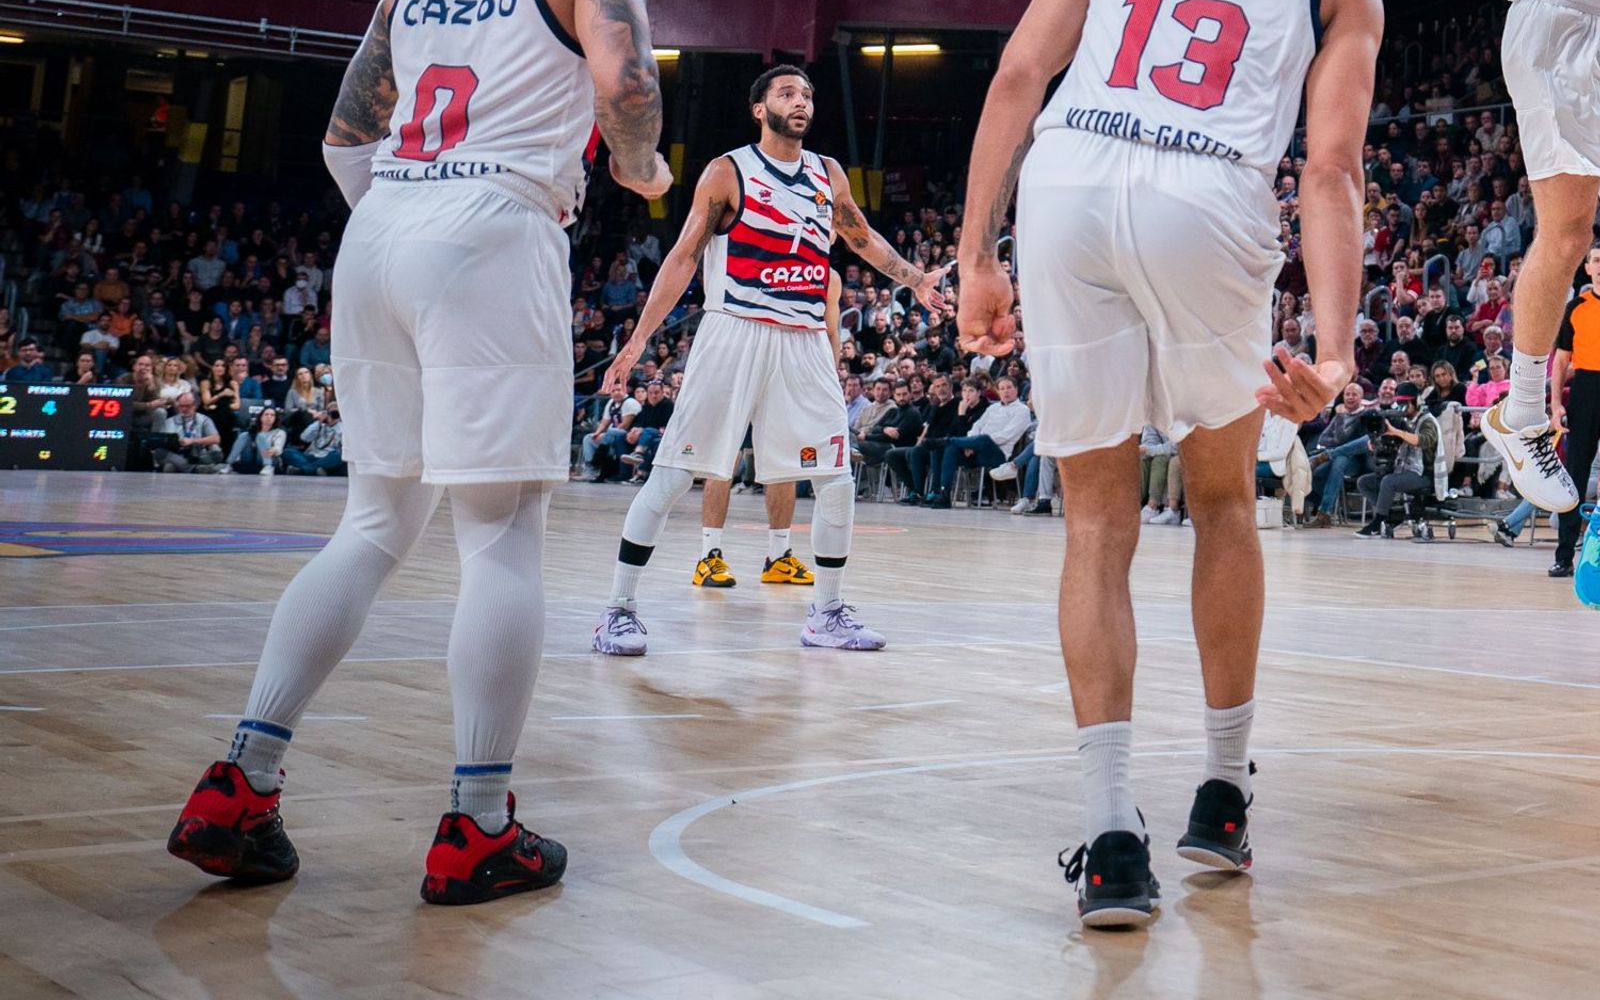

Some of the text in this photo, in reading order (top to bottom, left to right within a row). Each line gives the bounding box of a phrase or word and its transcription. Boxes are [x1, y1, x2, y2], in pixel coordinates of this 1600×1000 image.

[392, 63, 480, 162] 0
[787, 223, 804, 254] 7
[760, 265, 825, 284] CAZOO
[42, 400, 57, 415] 4
[88, 399, 121, 418] 79
[830, 435, 845, 467] 7
